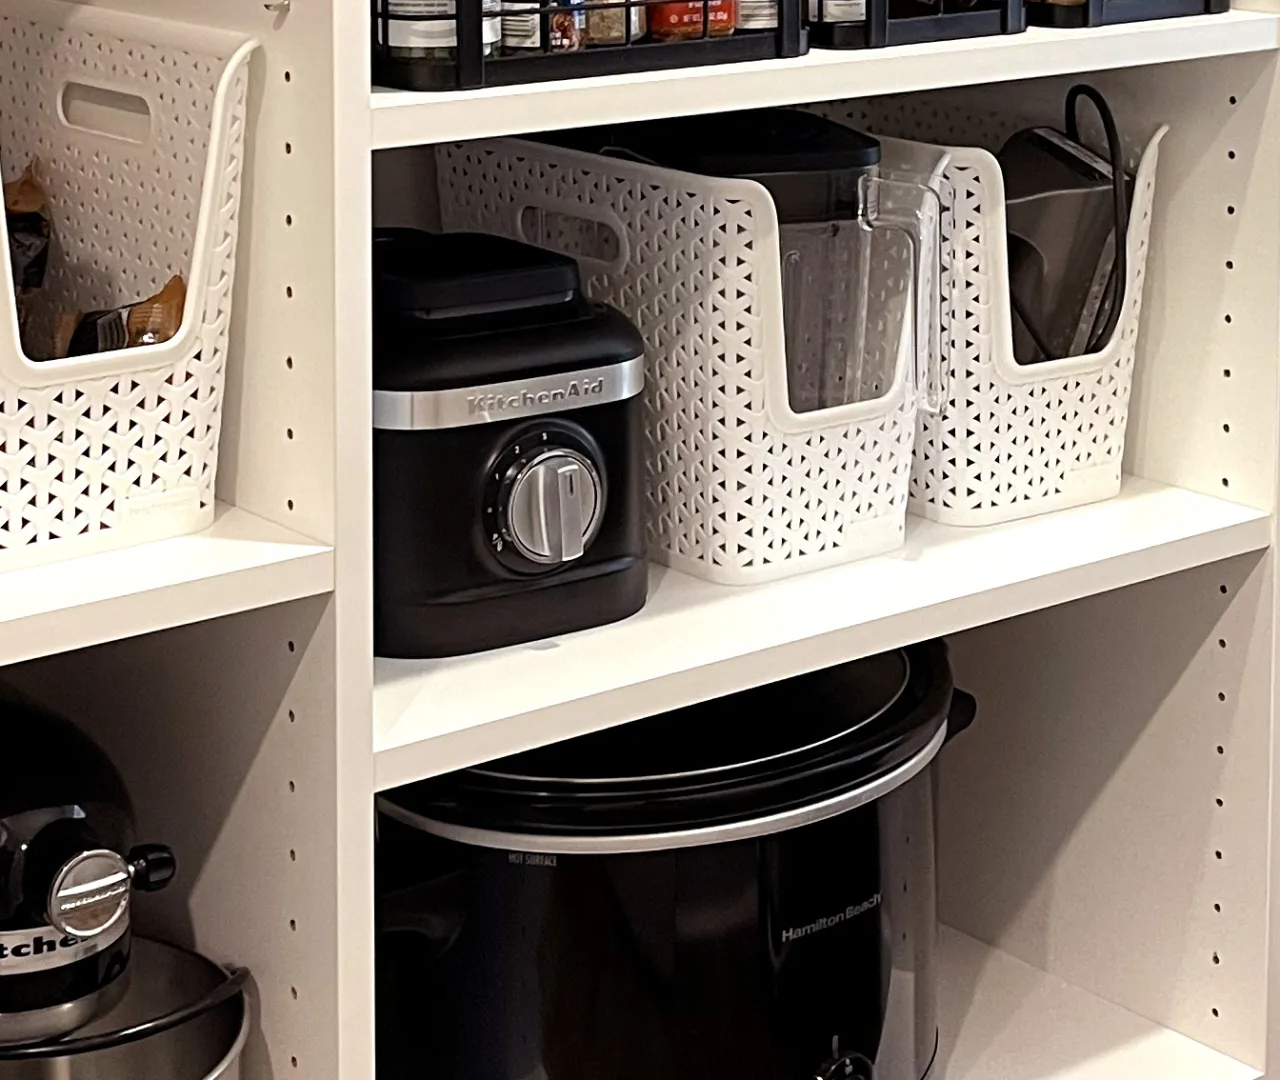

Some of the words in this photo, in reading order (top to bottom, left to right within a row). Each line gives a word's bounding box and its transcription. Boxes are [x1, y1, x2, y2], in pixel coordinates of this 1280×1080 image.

[467, 376, 605, 415] KitchenAid
[781, 911, 845, 943] Hamilton
[845, 890, 882, 920] Beach
